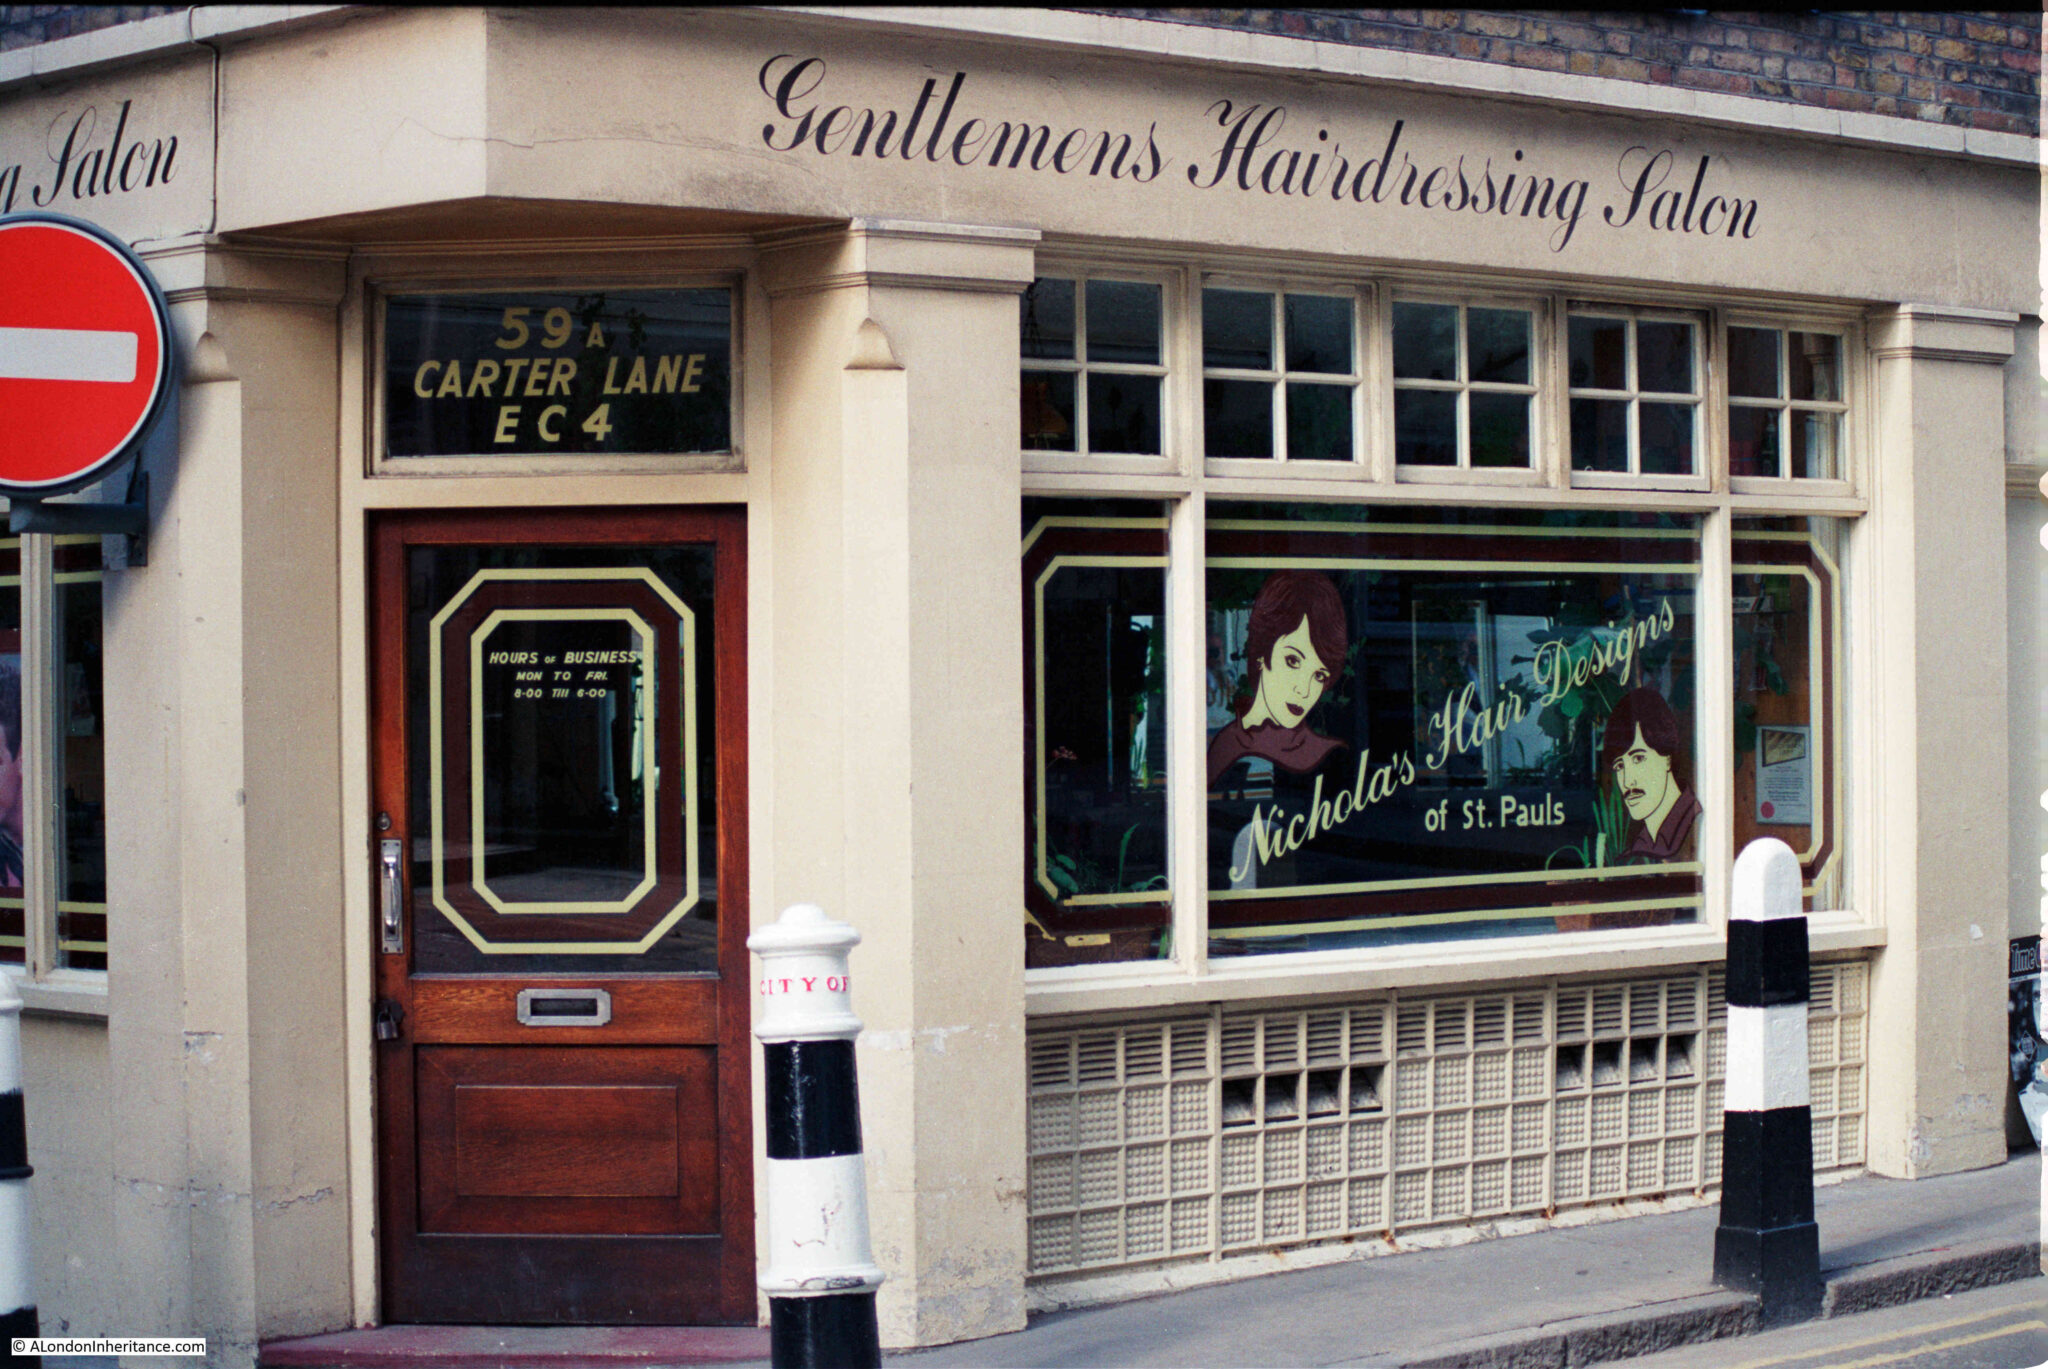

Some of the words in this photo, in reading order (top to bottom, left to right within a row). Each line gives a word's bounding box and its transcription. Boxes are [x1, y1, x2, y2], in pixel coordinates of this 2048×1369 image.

[32, 99, 180, 207] Salon
[758, 54, 1173, 183] Gentlemens
[1187, 100, 1588, 253] Hairdressing
[1602, 146, 1760, 239] Salon
[414, 358, 577, 398] CARTER
[603, 354, 705, 395] LANE
[489, 652, 539, 664] HOURS
[564, 651, 637, 664] BUSINESS
[516, 671, 543, 681] MON
[554, 671, 572, 681] TO
[1229, 748, 1415, 882] Nichola's
[1426, 682, 1525, 770] Hair
[1533, 596, 1676, 708] Designs
[1425, 799, 1448, 832] of
[1462, 801, 1493, 830] St.
[1501, 793, 1566, 828] Pauls
[760, 976, 817, 995] CITY
